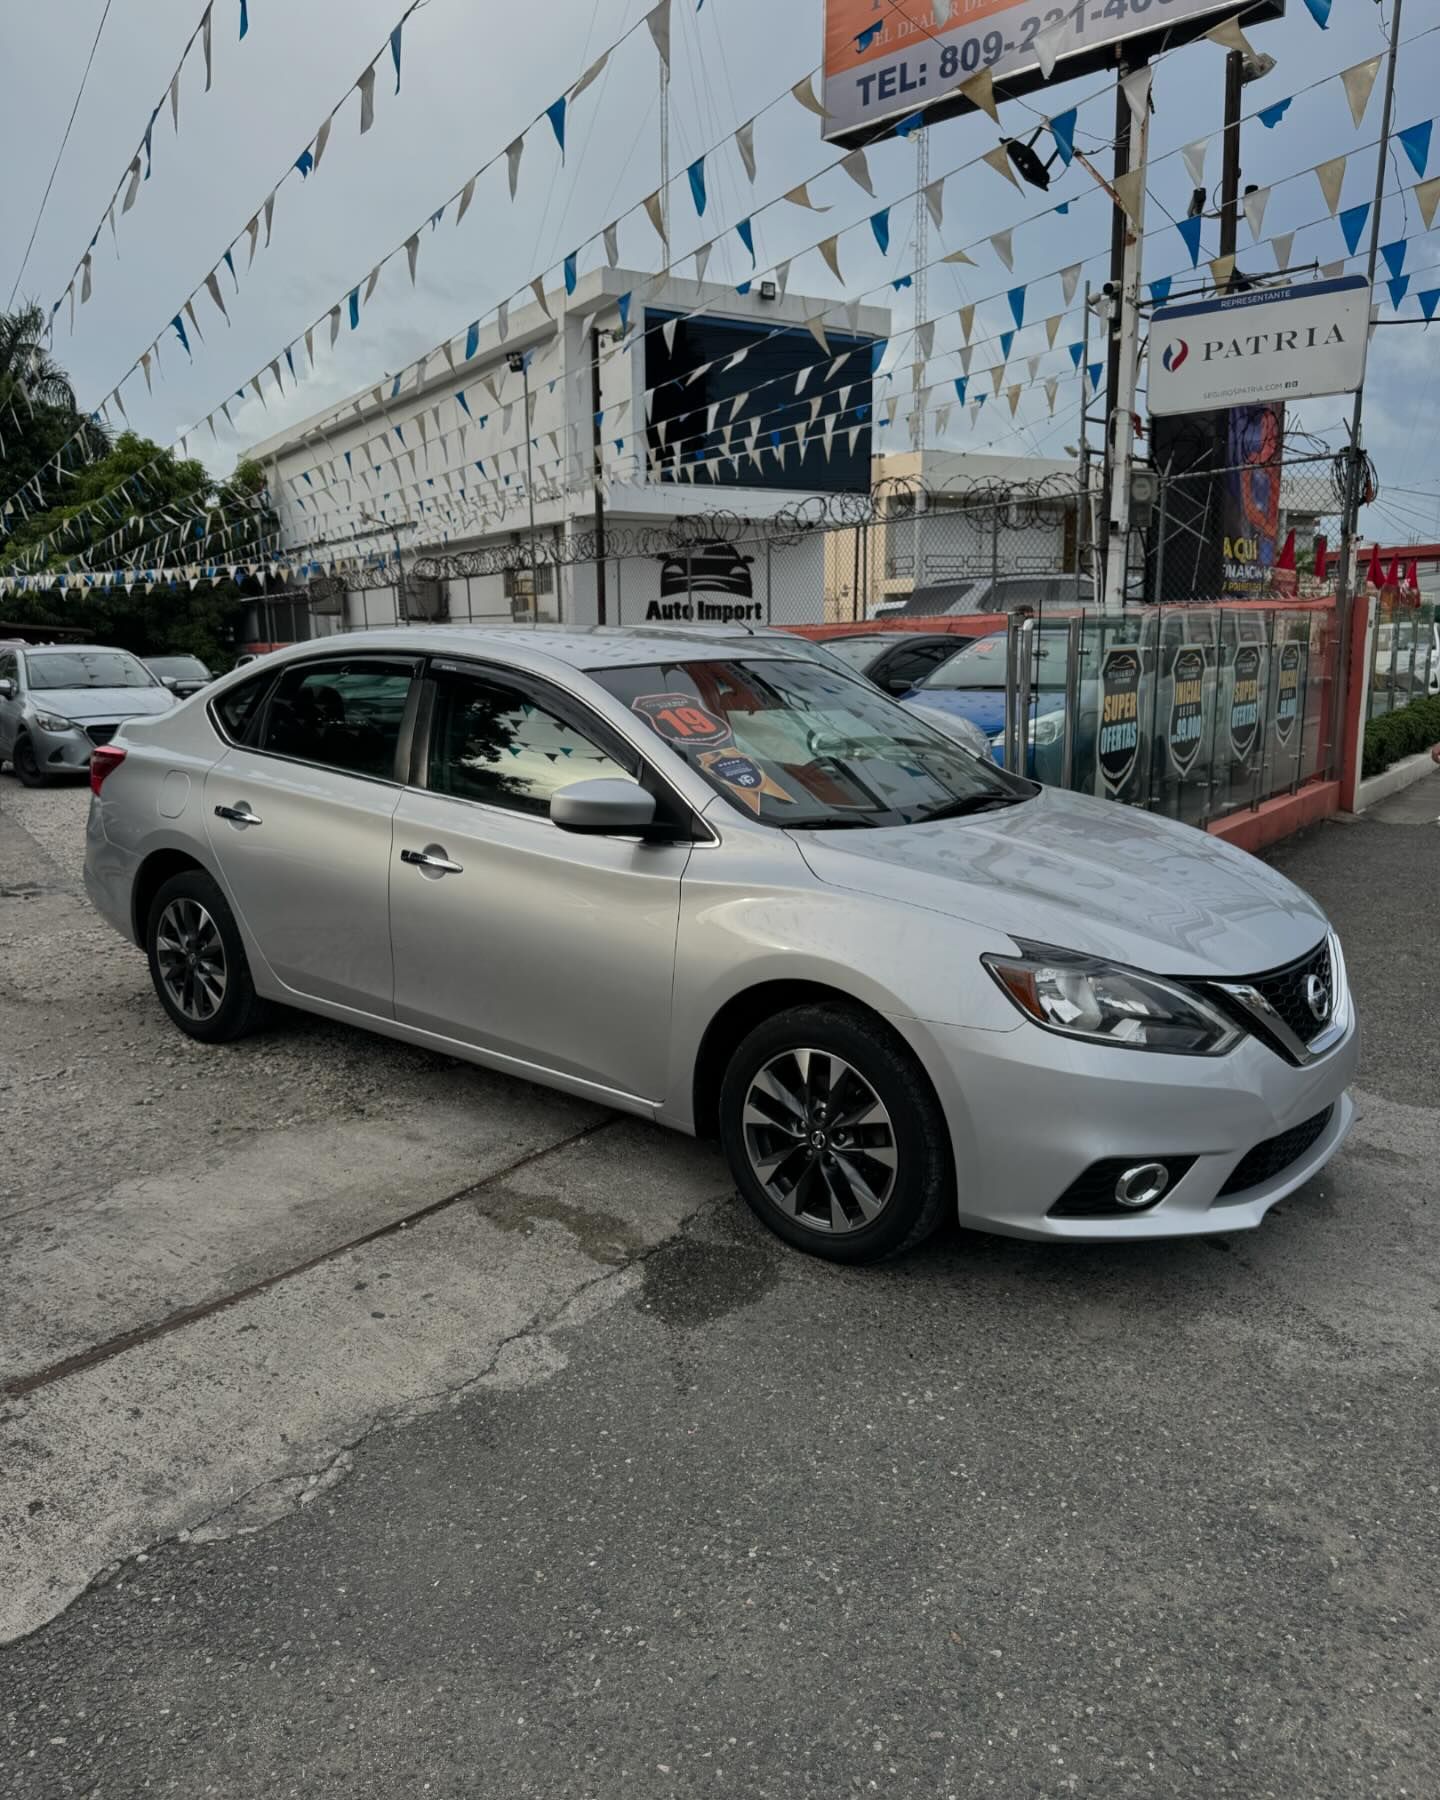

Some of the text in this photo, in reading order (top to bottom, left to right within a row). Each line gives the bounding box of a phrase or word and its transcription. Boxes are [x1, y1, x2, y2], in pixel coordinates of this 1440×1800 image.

[897, 1, 959, 37] DEALR
[856, 62, 927, 107] TEL:
[1220, 289, 1292, 308] REPRESENTANTE
[1202, 323, 1345, 361] PATRIA
[645, 600, 762, 624] Auto Import
[1234, 680, 1257, 703] SUPER
[1104, 692, 1136, 721] SUPER
[1232, 703, 1256, 728] OFERTAS
[656, 707, 717, 736] 19
[1101, 722, 1137, 754] OFERTAS
